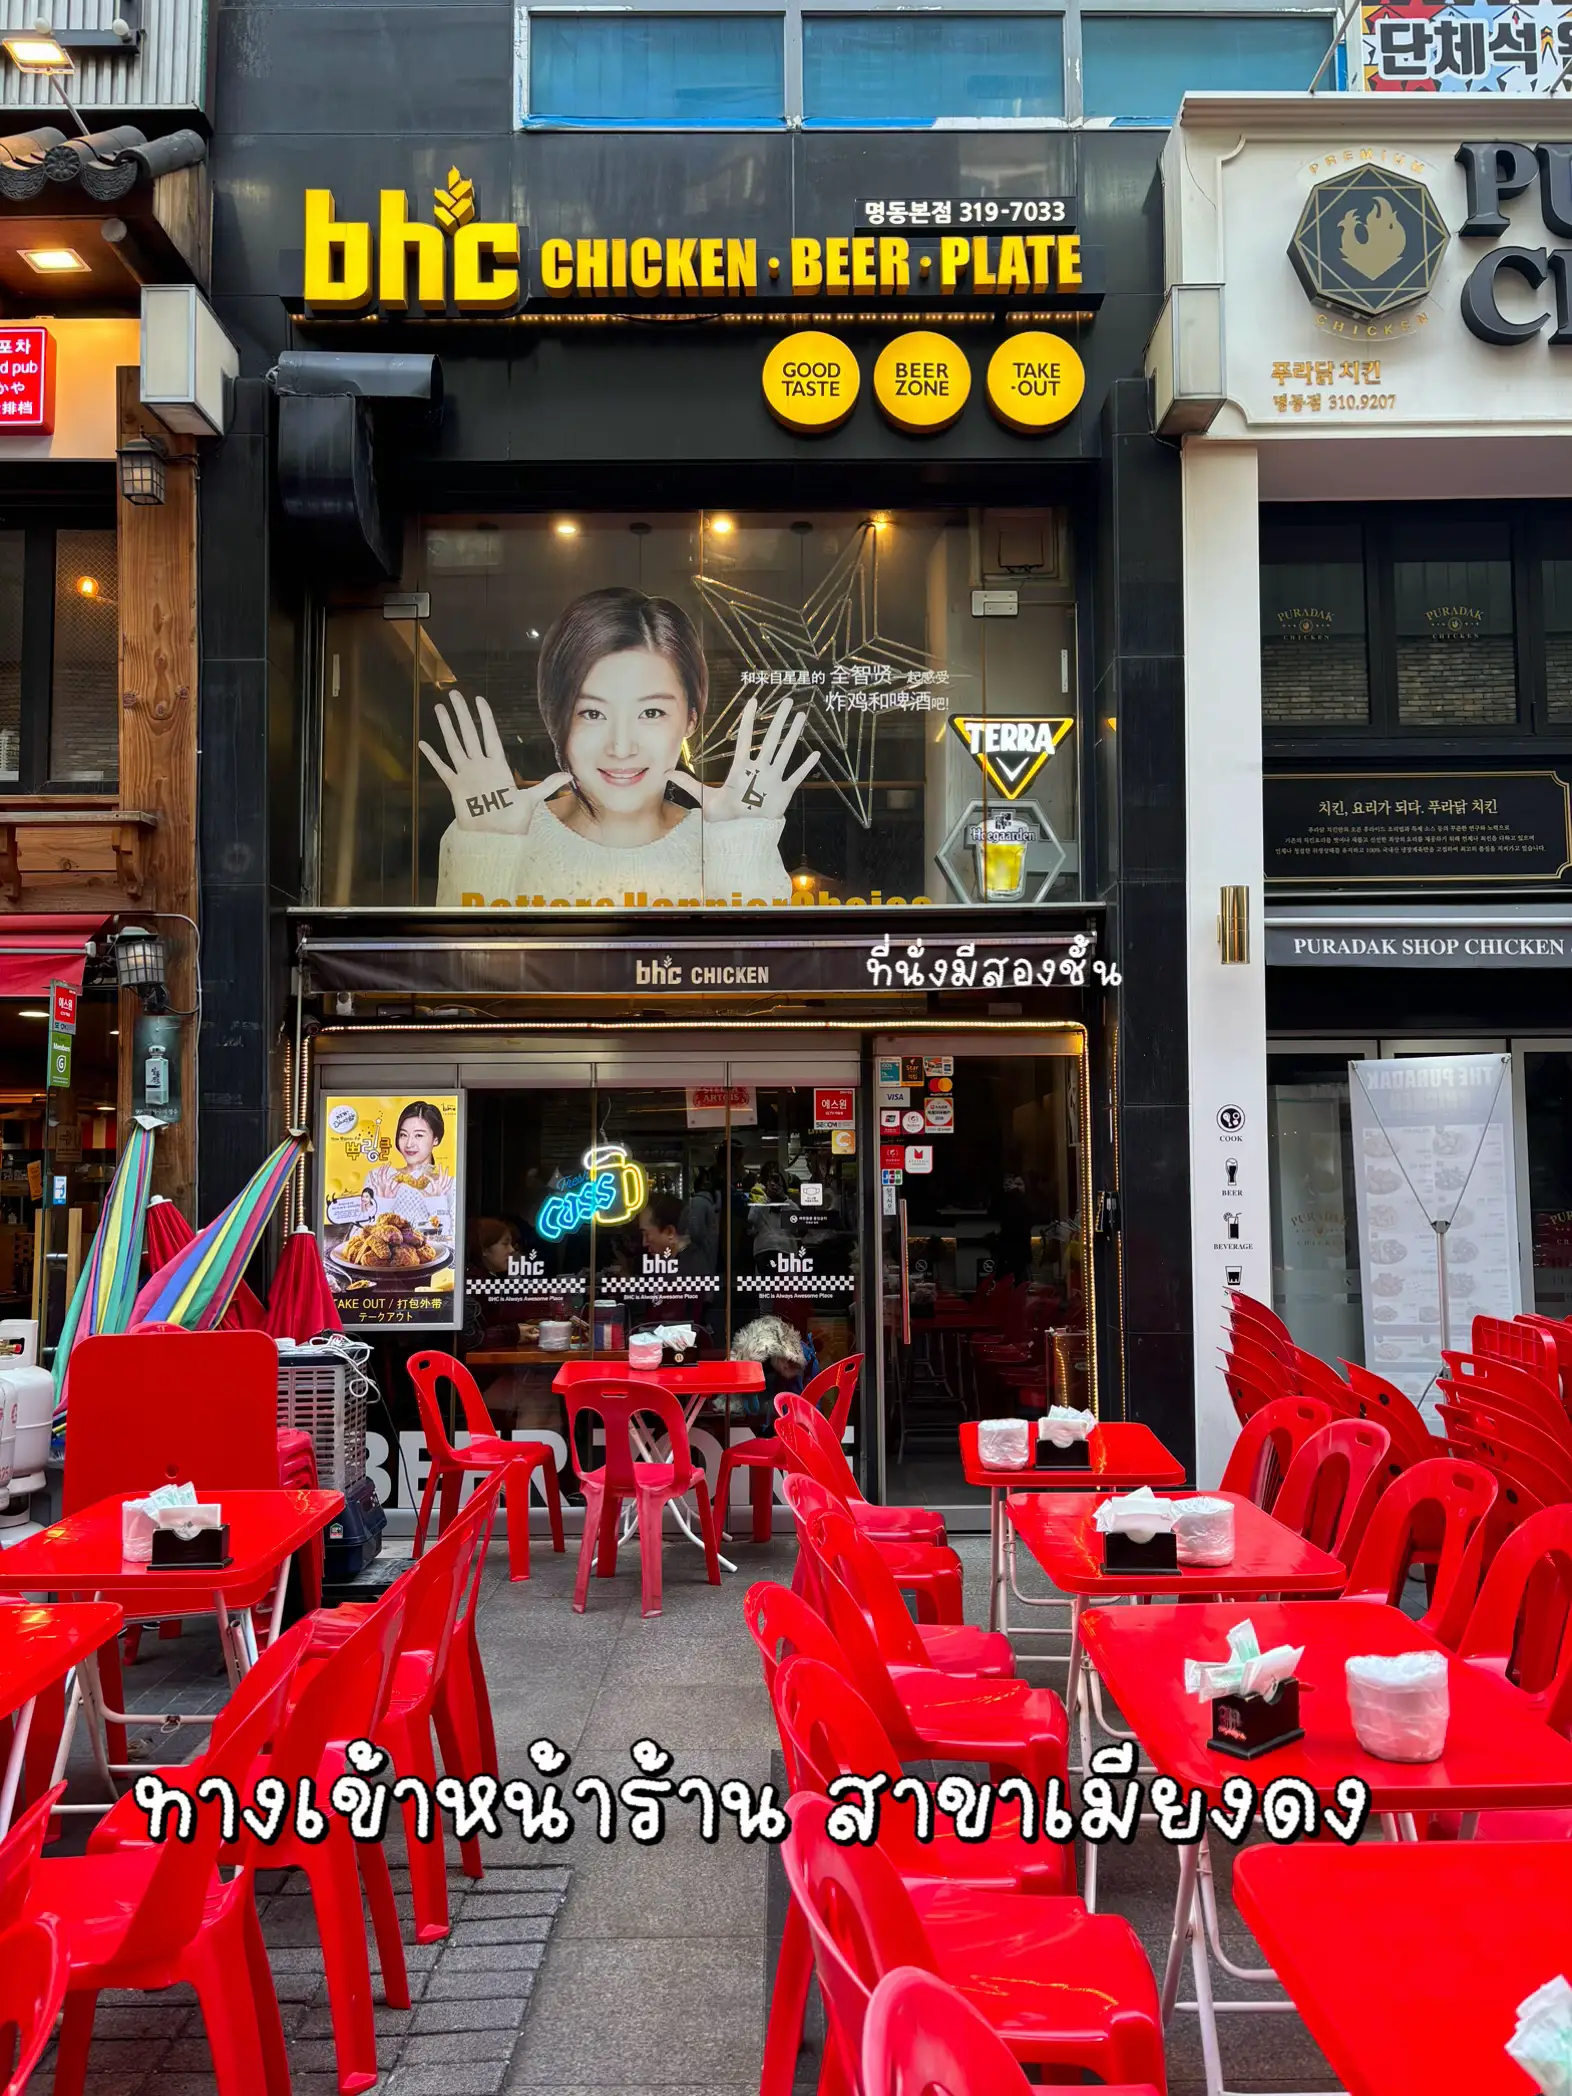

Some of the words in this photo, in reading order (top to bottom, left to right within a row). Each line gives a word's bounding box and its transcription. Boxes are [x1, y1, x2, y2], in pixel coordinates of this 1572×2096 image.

[1379, 20, 1538, 76] 단체석
[1308, 147, 1427, 176] PREMIUM
[865, 200, 952, 226] 명동본점
[959, 201, 1066, 223] 319-7033
[304, 188, 520, 312] bhc
[540, 237, 757, 298] CHICKEN
[790, 236, 910, 296] BEER
[940, 235, 1083, 295] PLATE
[1315, 311, 1430, 337] CHICKEN
[12, 360, 39, 377] pub
[782, 362, 841, 378] GOOD
[895, 362, 949, 378] BEER
[1013, 362, 1061, 378] TAKE
[1271, 360, 1334, 387] 푸라닭
[1339, 359, 1382, 386] 치킨
[781, 380, 841, 397] TASTE
[895, 380, 949, 397] ZONE
[1272, 393, 1322, 413] 명동점
[1328, 393, 1396, 411] 310.9207
[1276, 607, 1336, 623] PURADAK
[1424, 605, 1485, 621] PURADAK
[740, 670, 826, 686] 和来自星星的
[830, 665, 893, 686] 全智贤
[964, 722, 1056, 755] TERRA
[465, 787, 514, 818] BHC
[1319, 800, 1349, 816] 치킨,
[1351, 800, 1392, 816] 요리가
[1395, 800, 1425, 816] 되다.
[1428, 799, 1467, 815] 푸라닭
[1472, 798, 1498, 814] 치킨
[971, 827, 1036, 843] Hoegaarden
[1293, 938, 1397, 955] PURADAK
[1402, 938, 1460, 955] SHOP
[1464, 938, 1565, 956] CHICKEN
[636, 959, 682, 985] bhc
[691, 966, 769, 985] CHICKEN
[821, 1099, 847, 1110] 에스원
[886, 1093, 904, 1101] VISA
[1219, 1135, 1243, 1143] COOK
[1221, 1189, 1243, 1197] BEER
[1213, 1242, 1254, 1251] BEVERAGE
[508, 1255, 545, 1276] bhc
[642, 1253, 679, 1274] bhc
[777, 1252, 813, 1273] bhc
[363, 1298, 386, 1309] OUT
[359, 1312, 413, 1322] テークアウト
